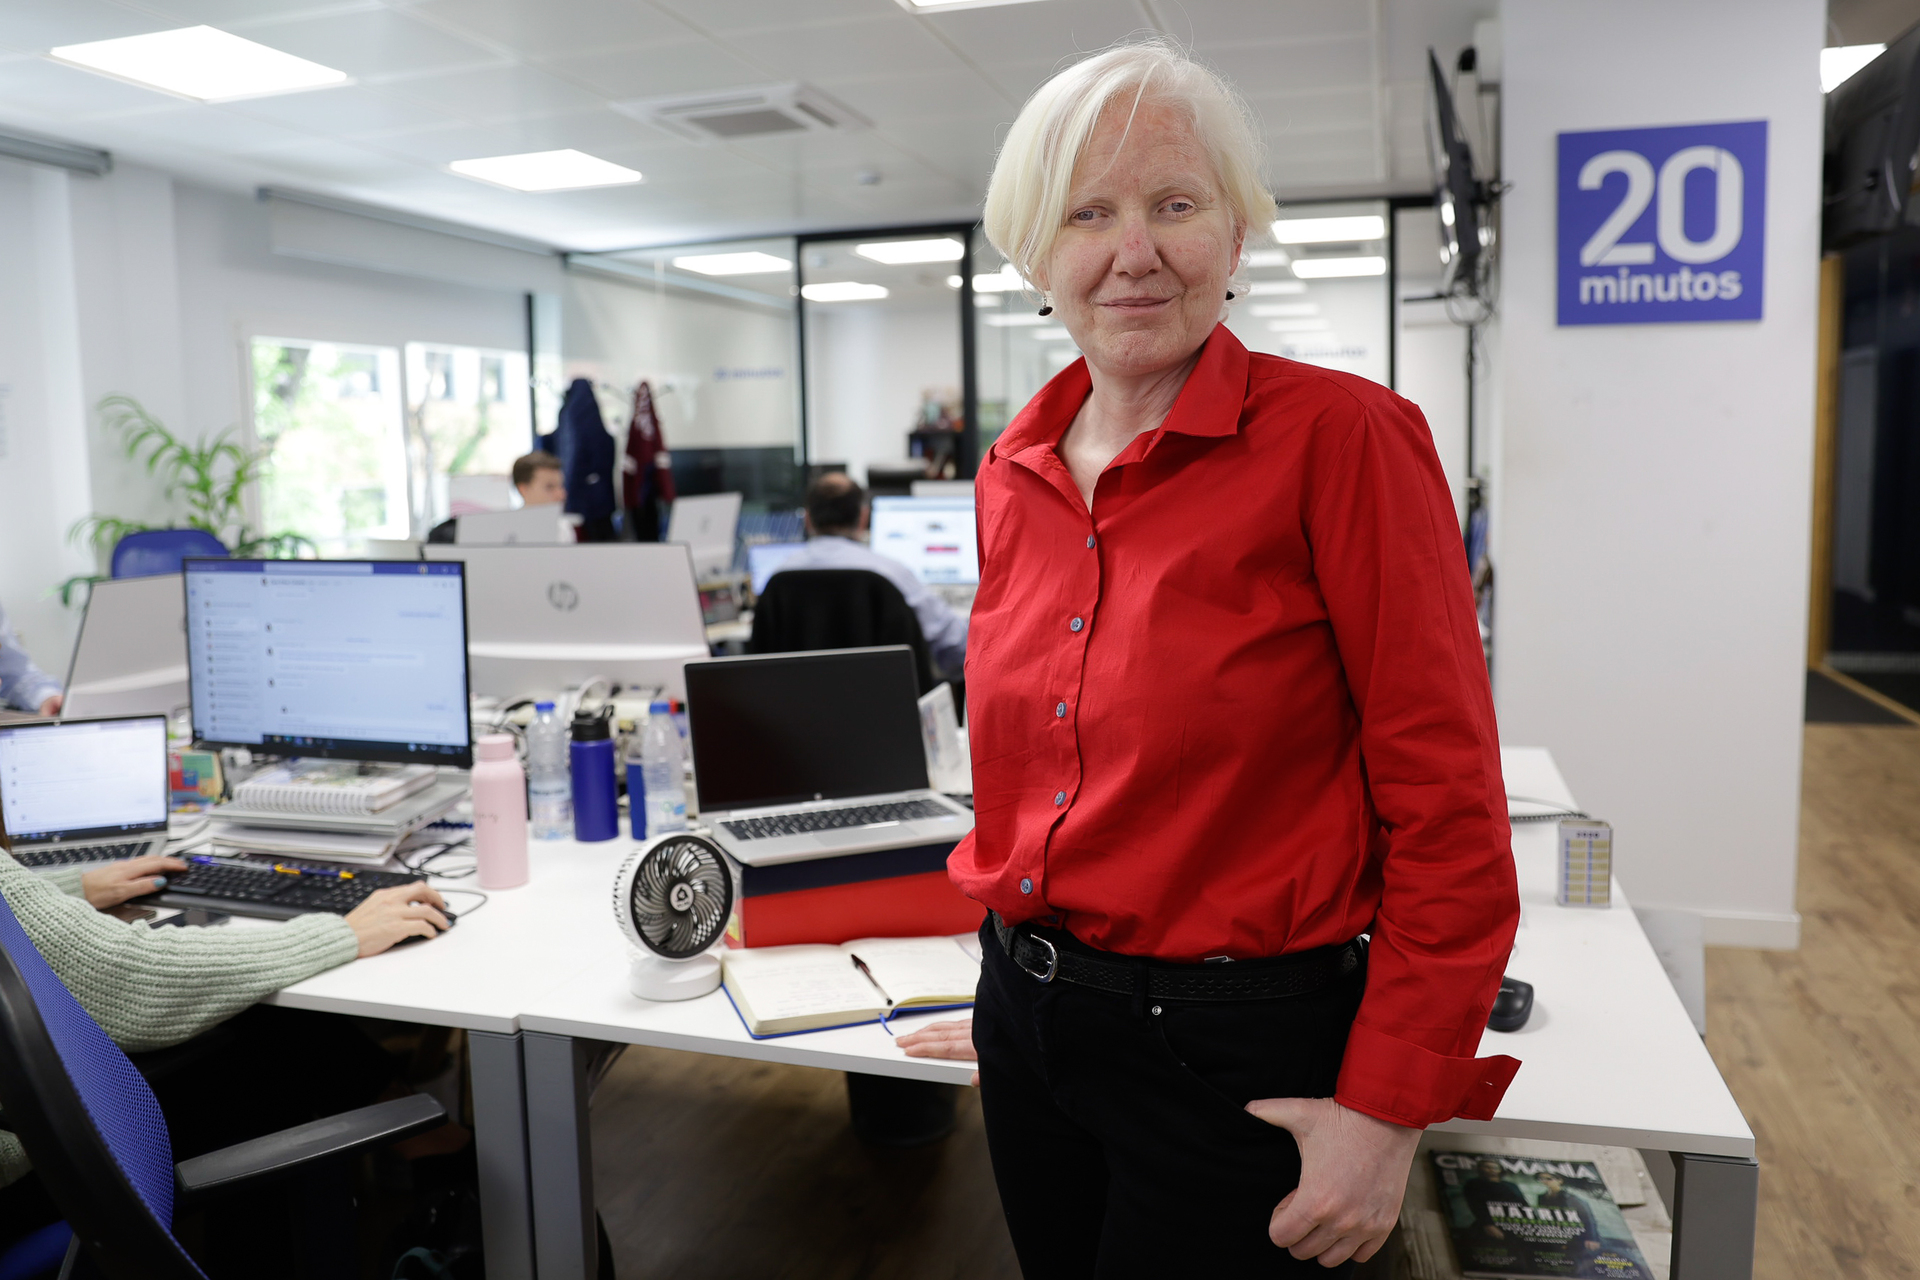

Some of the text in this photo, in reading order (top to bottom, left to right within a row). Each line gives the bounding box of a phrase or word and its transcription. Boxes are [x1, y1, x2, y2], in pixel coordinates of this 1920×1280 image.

[1577, 144, 1744, 267] 20
[1579, 266, 1743, 305] minutos
[1434, 1155, 1597, 1180] CINMANIA
